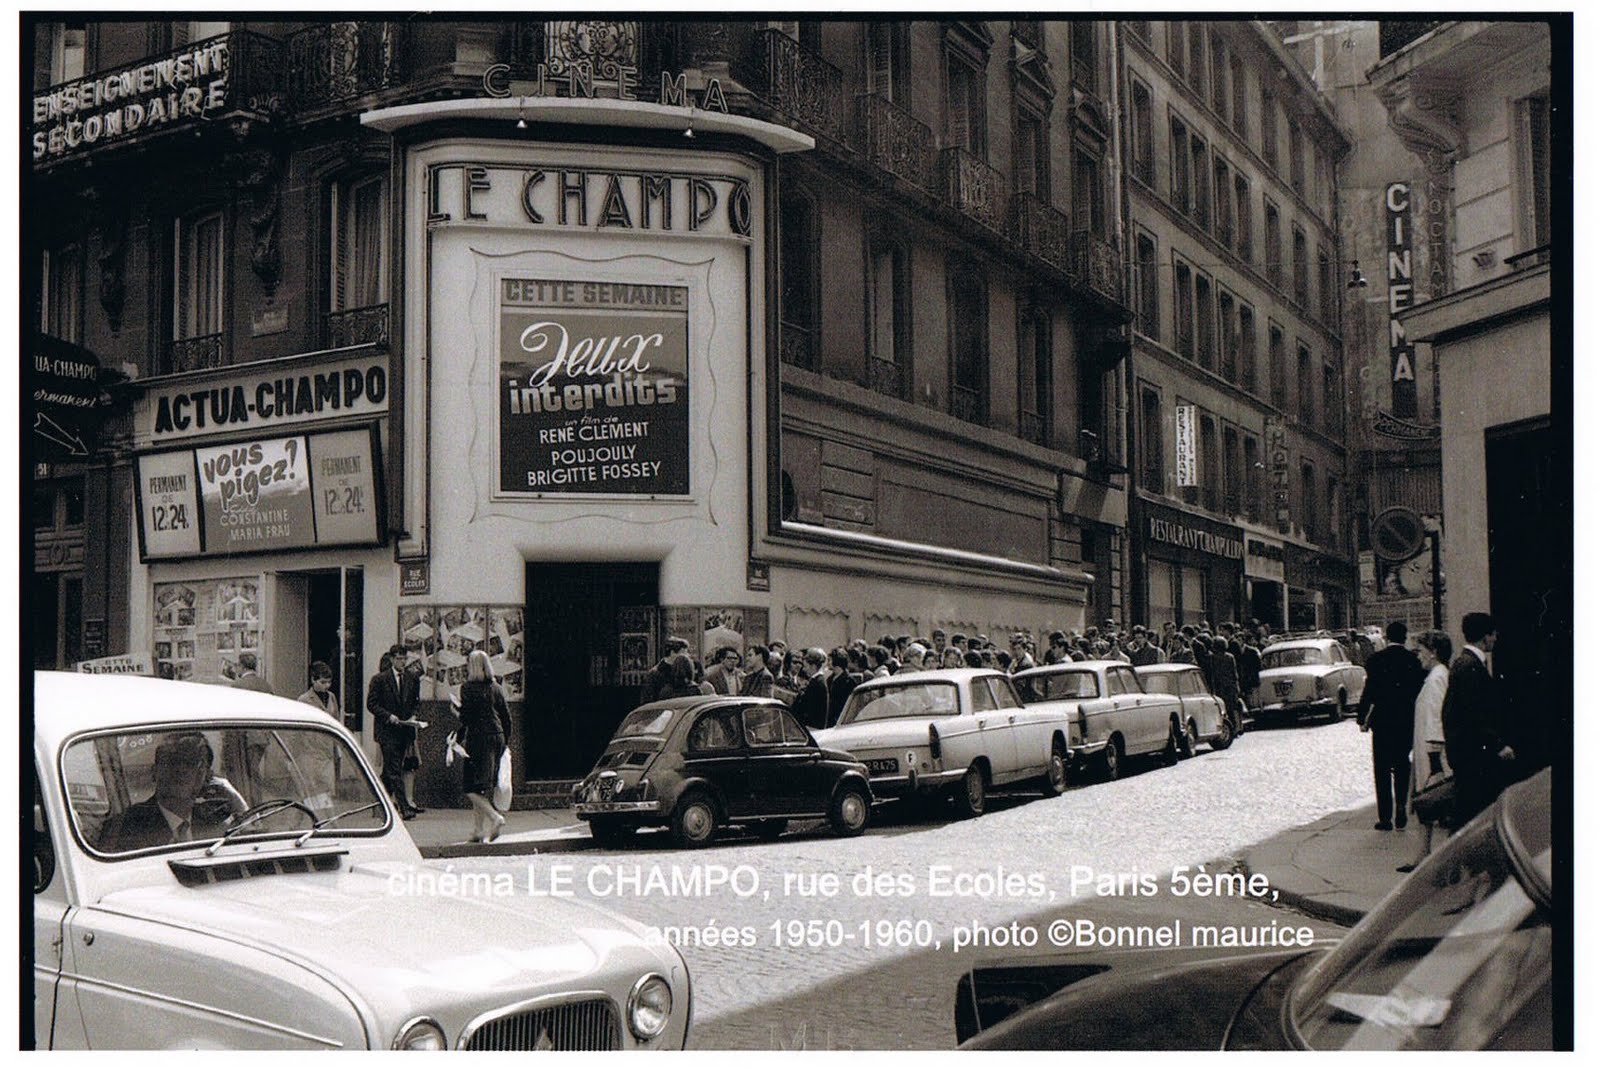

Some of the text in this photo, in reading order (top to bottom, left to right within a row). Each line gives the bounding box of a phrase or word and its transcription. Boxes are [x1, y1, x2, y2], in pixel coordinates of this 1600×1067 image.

[33, 42, 228, 124] ENSEIGNEMENT
[483, 63, 729, 113] CINEMA
[33, 79, 226, 159] SECONDAIRE
[427, 165, 753, 237] LE CHAMPO
[505, 280, 683, 306] CETTE SEMAINE
[1387, 183, 1414, 382] CINEMA
[520, 321, 663, 387] Jeux
[154, 365, 386, 434] ACTUA-CHAMPO
[509, 371, 677, 415] interdits
[580, 414, 600, 425] film
[604, 416, 619, 424] de
[551, 444, 637, 466] POUJOULY
[1178, 408, 1187, 485] RESTAURANT
[321, 455, 361, 476] PERMANENT
[527, 460, 661, 486] BRIGITTE FOSSEY
[150, 475, 187, 494] PERMANENT
[220, 508, 289, 526] CONSTANTINE
[230, 527, 263, 541] MARIA
[82, 662, 145, 675] SEMAINE
